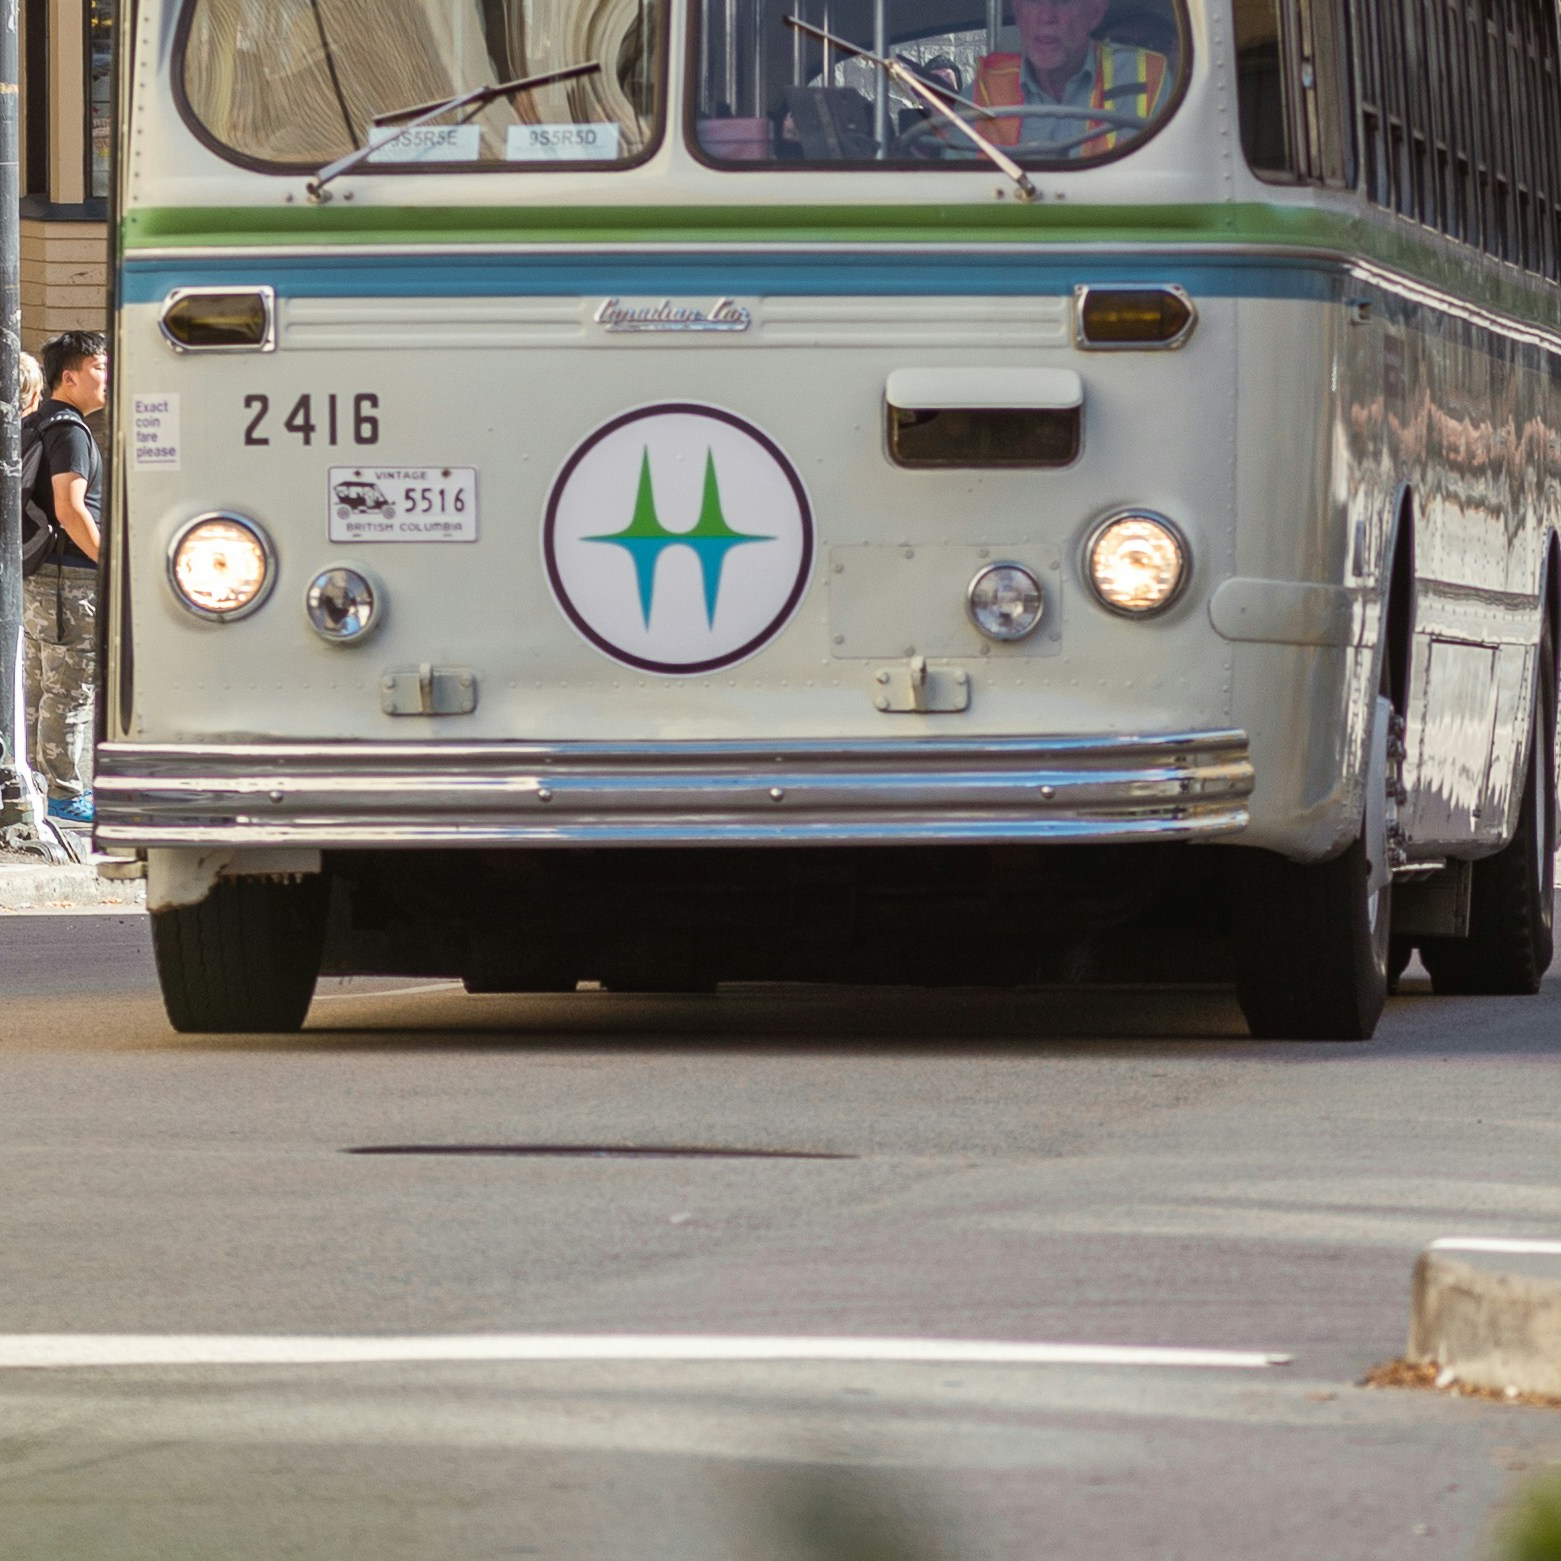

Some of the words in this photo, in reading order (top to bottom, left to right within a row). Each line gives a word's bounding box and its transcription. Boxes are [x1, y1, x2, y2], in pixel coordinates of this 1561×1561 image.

[135, 400, 169, 413] Exact
[135, 416, 161, 428] coin
[243, 392, 380, 446] 2416
[136, 431, 158, 443] fare
[136, 445, 176, 459] please
[374, 470, 429, 481] VINTAGE
[403, 487, 466, 513] 5516
[346, 522, 394, 533] BRITISH
[399, 522, 463, 533] COLUMBIA
